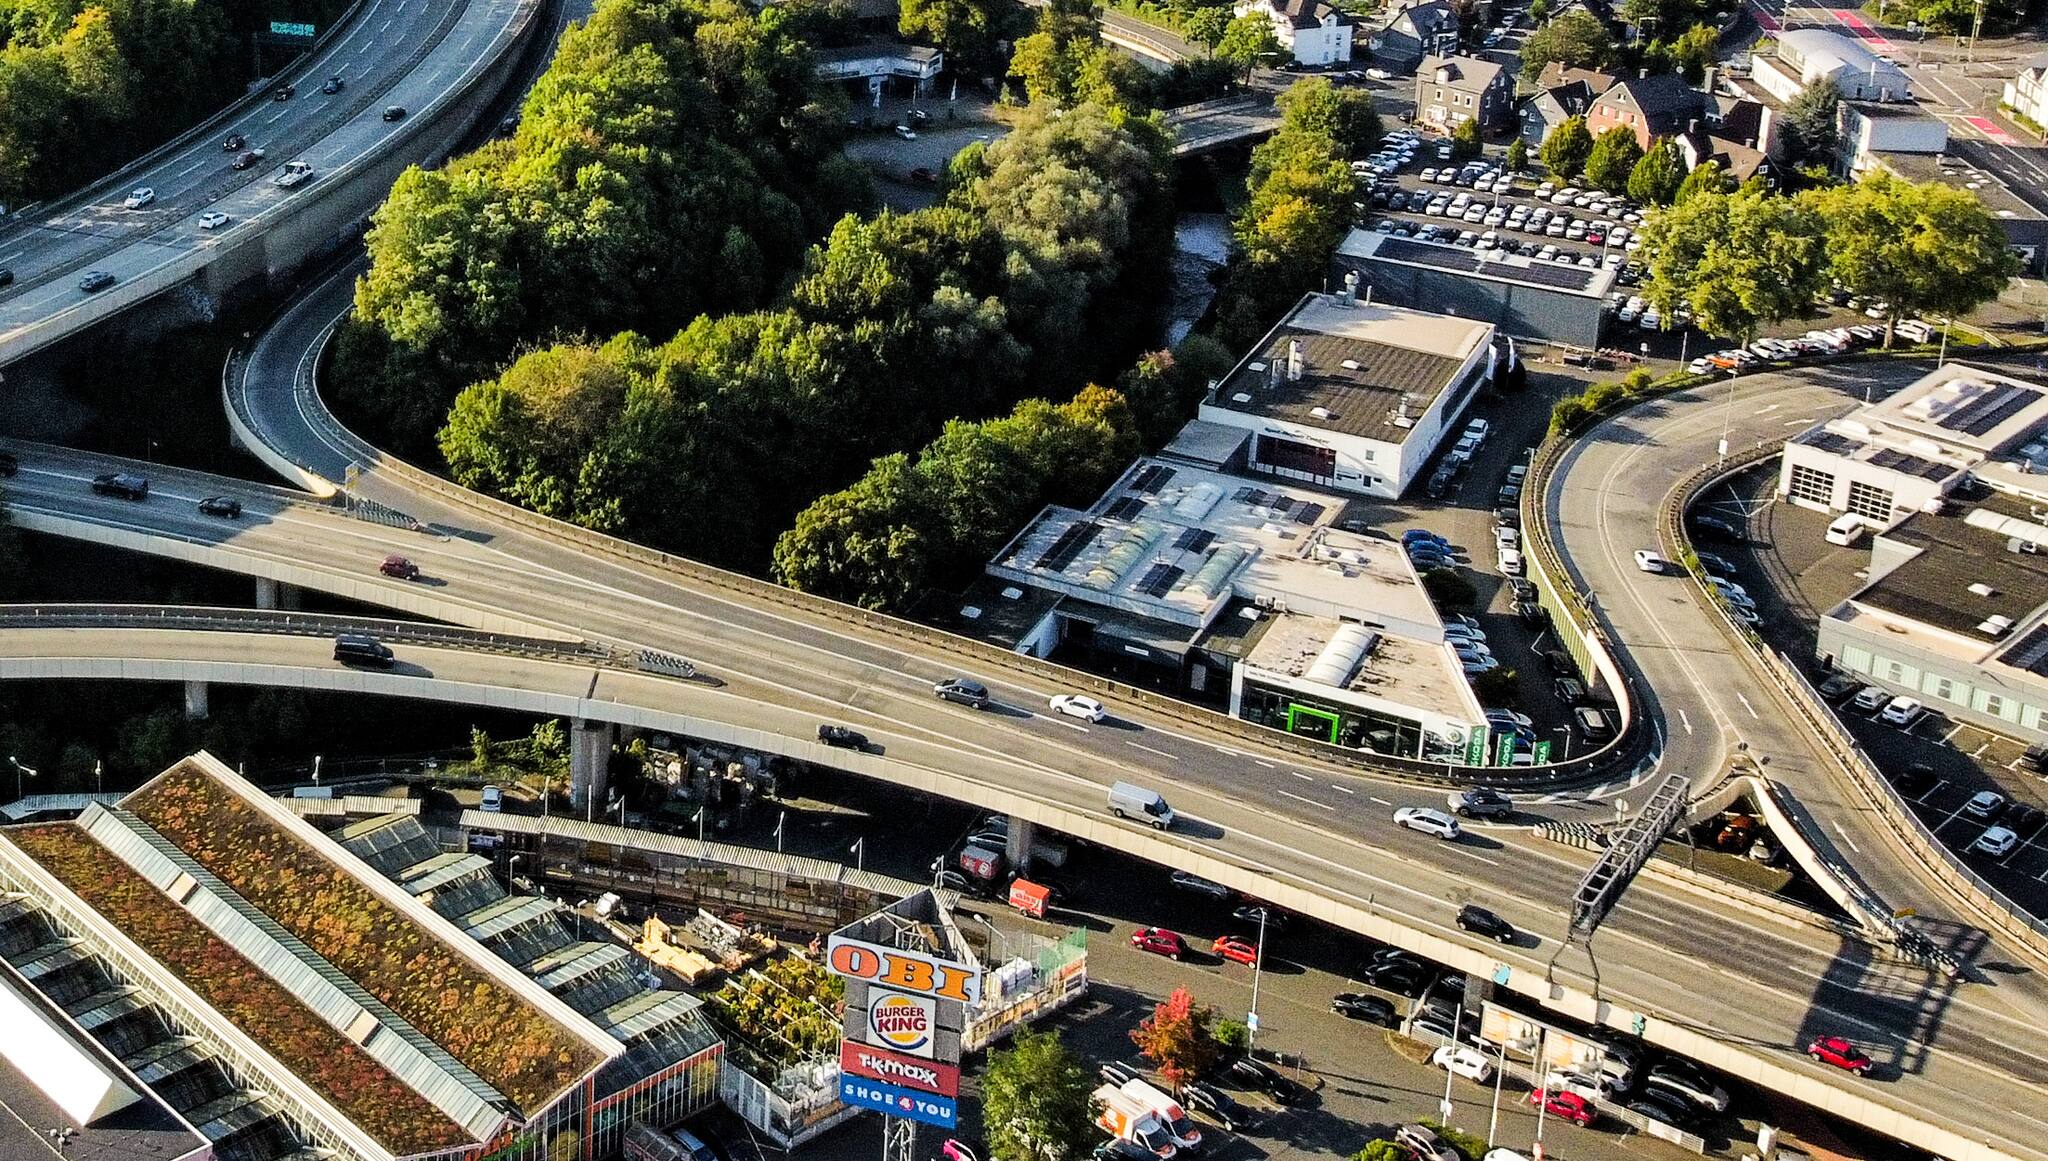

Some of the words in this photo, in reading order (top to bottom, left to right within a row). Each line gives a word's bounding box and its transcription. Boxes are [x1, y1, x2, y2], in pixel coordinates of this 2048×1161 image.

[1502, 737, 1512, 767] KODA
[831, 944, 974, 1001] OBI
[876, 1007, 925, 1018] BURGER
[877, 1017, 927, 1032] KING
[845, 1084, 894, 1105] SHOE
[899, 1097, 911, 1109] 4
[916, 1101, 951, 1118] YOU
